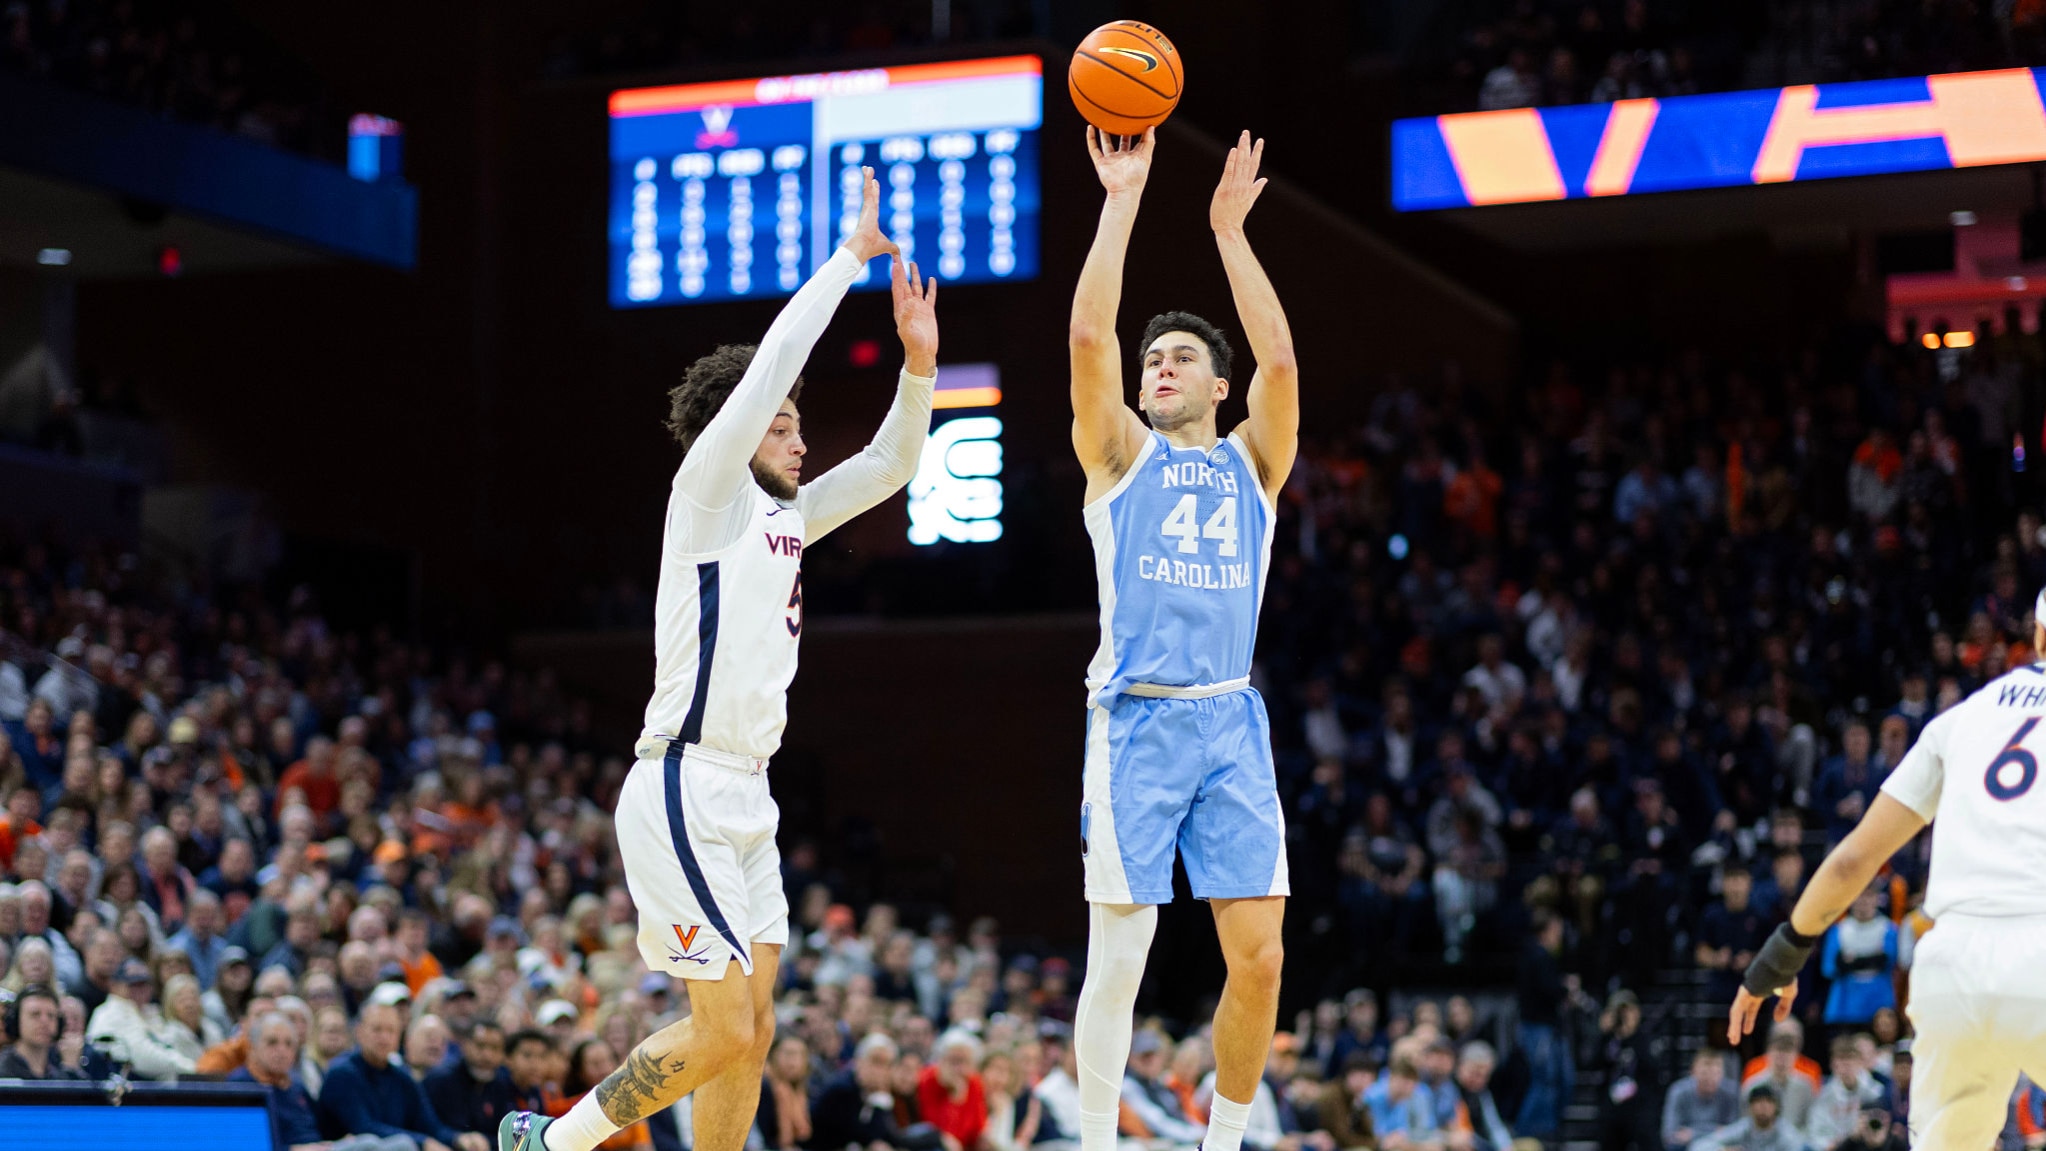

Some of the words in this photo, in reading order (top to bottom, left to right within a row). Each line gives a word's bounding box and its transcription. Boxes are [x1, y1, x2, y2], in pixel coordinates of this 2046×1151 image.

[1160, 494, 1238, 557] 44
[1138, 555, 1251, 590] CAROLINA
[1984, 715, 2043, 802] 6
[672, 924, 702, 954] V
